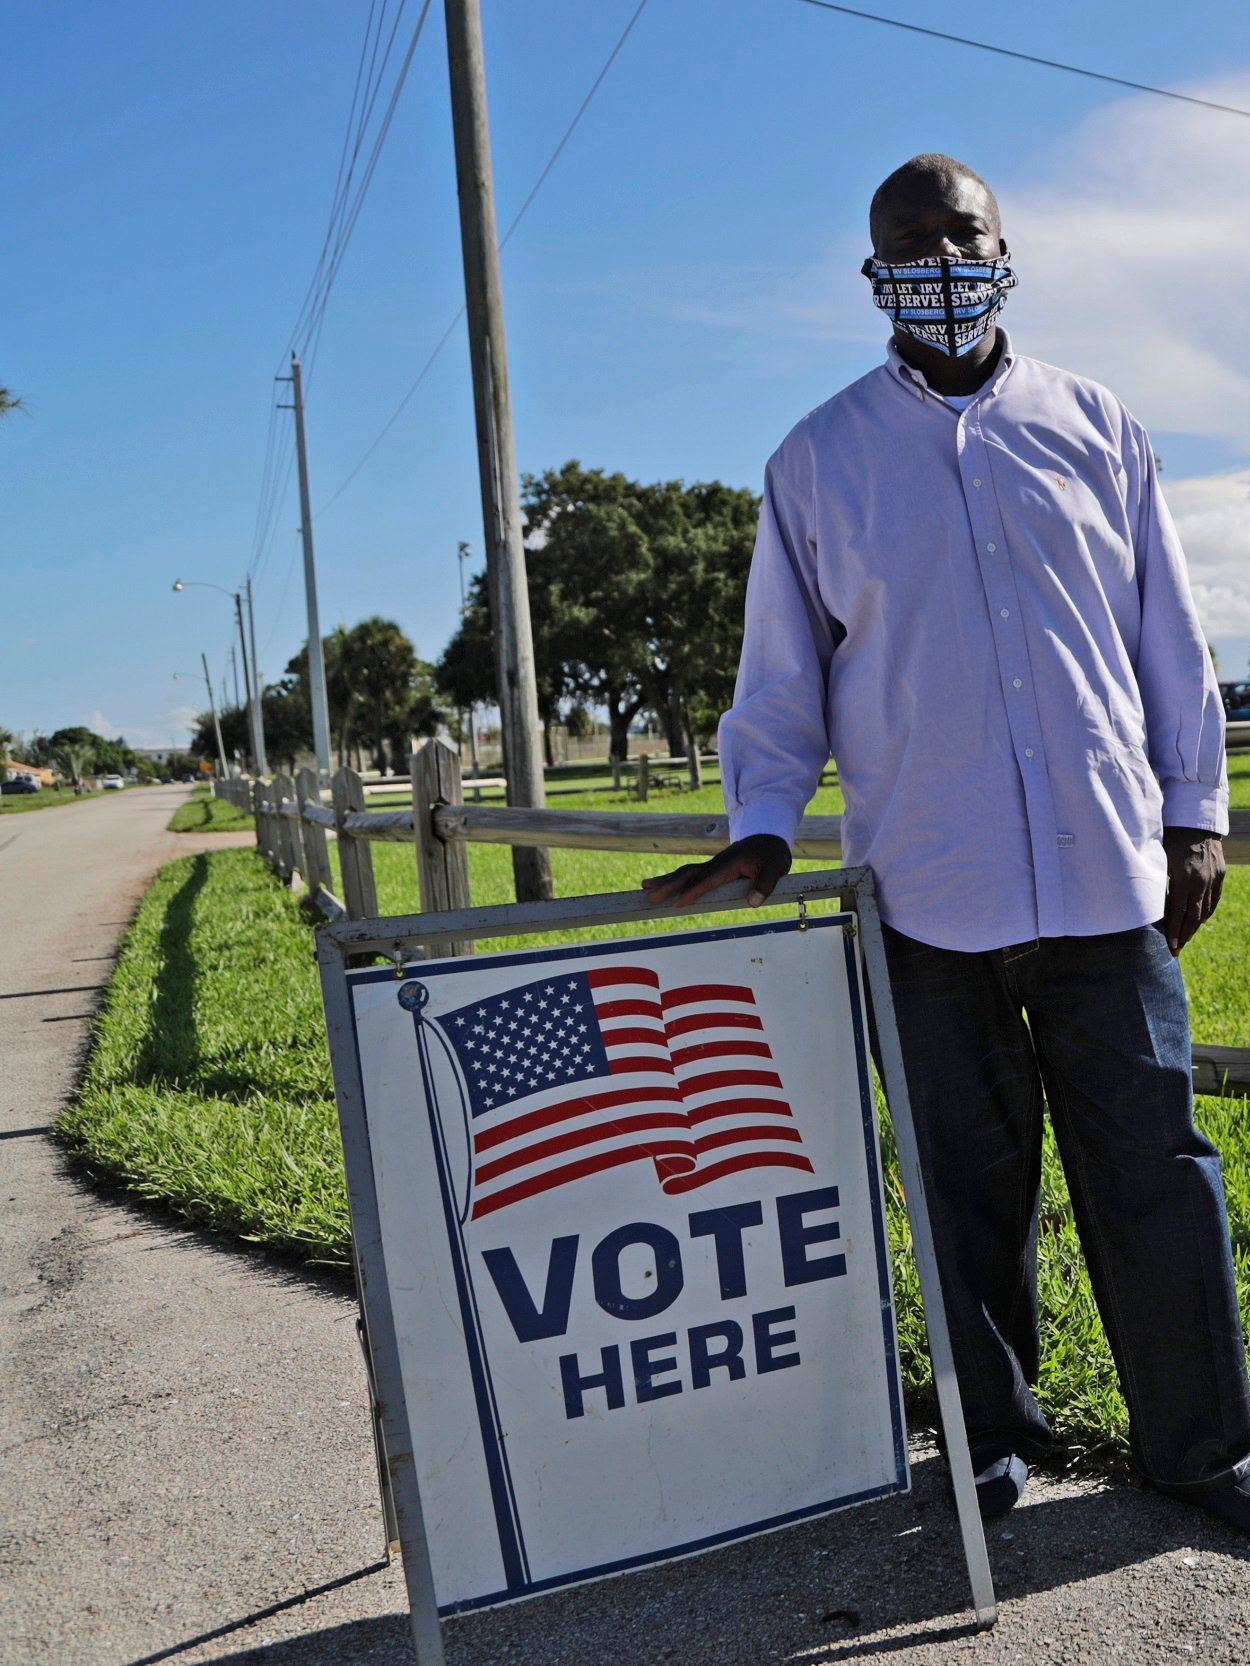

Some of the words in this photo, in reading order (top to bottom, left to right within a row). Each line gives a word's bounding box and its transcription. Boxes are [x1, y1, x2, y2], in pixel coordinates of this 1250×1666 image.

[896, 283, 913, 293] LET
[920, 283, 943, 293] IRV
[950, 282, 971, 293] LET
[873, 294, 896, 307] RVE!
[899, 293, 945, 307] SERVE!
[924, 324, 947, 335] IRV
[954, 323, 974, 334] LET
[481, 1185, 848, 1344] VOTE
[558, 1305, 802, 1420] HERE
